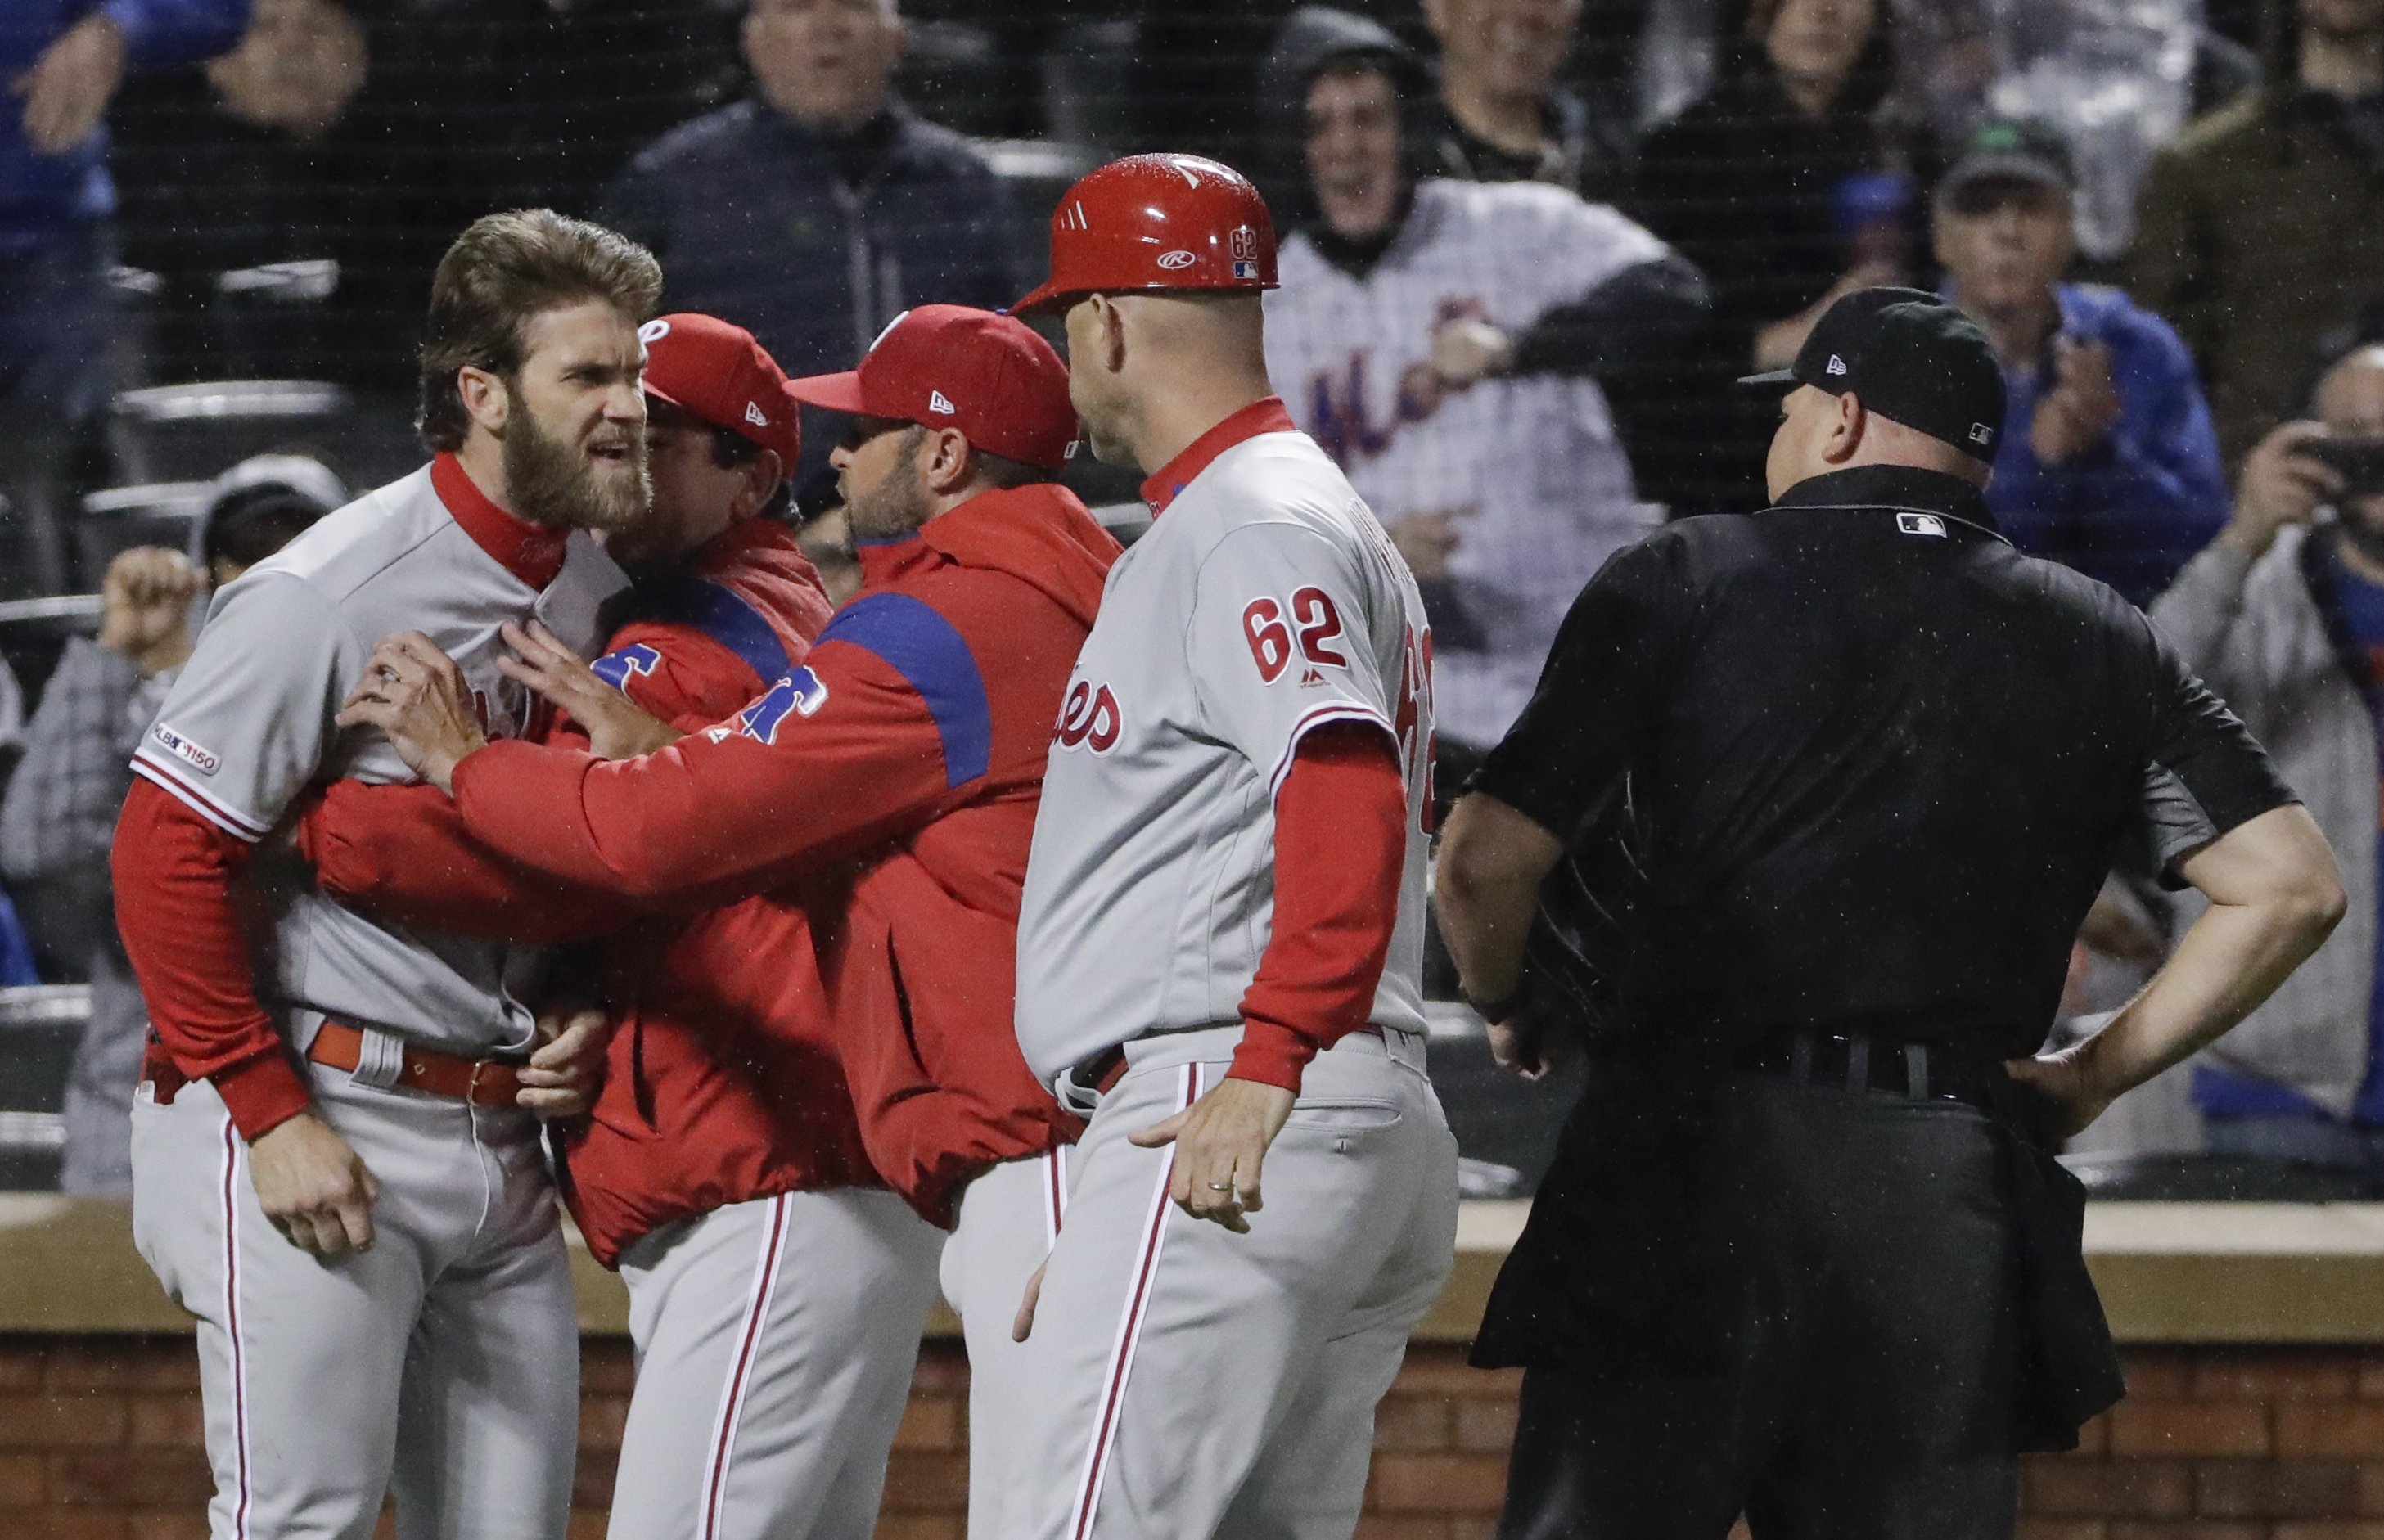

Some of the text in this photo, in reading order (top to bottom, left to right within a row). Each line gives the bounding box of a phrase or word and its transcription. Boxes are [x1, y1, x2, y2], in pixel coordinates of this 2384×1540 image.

[1229, 228, 1258, 259] 62
[1242, 585, 1349, 687] 62
[190, 748, 215, 769] 150
